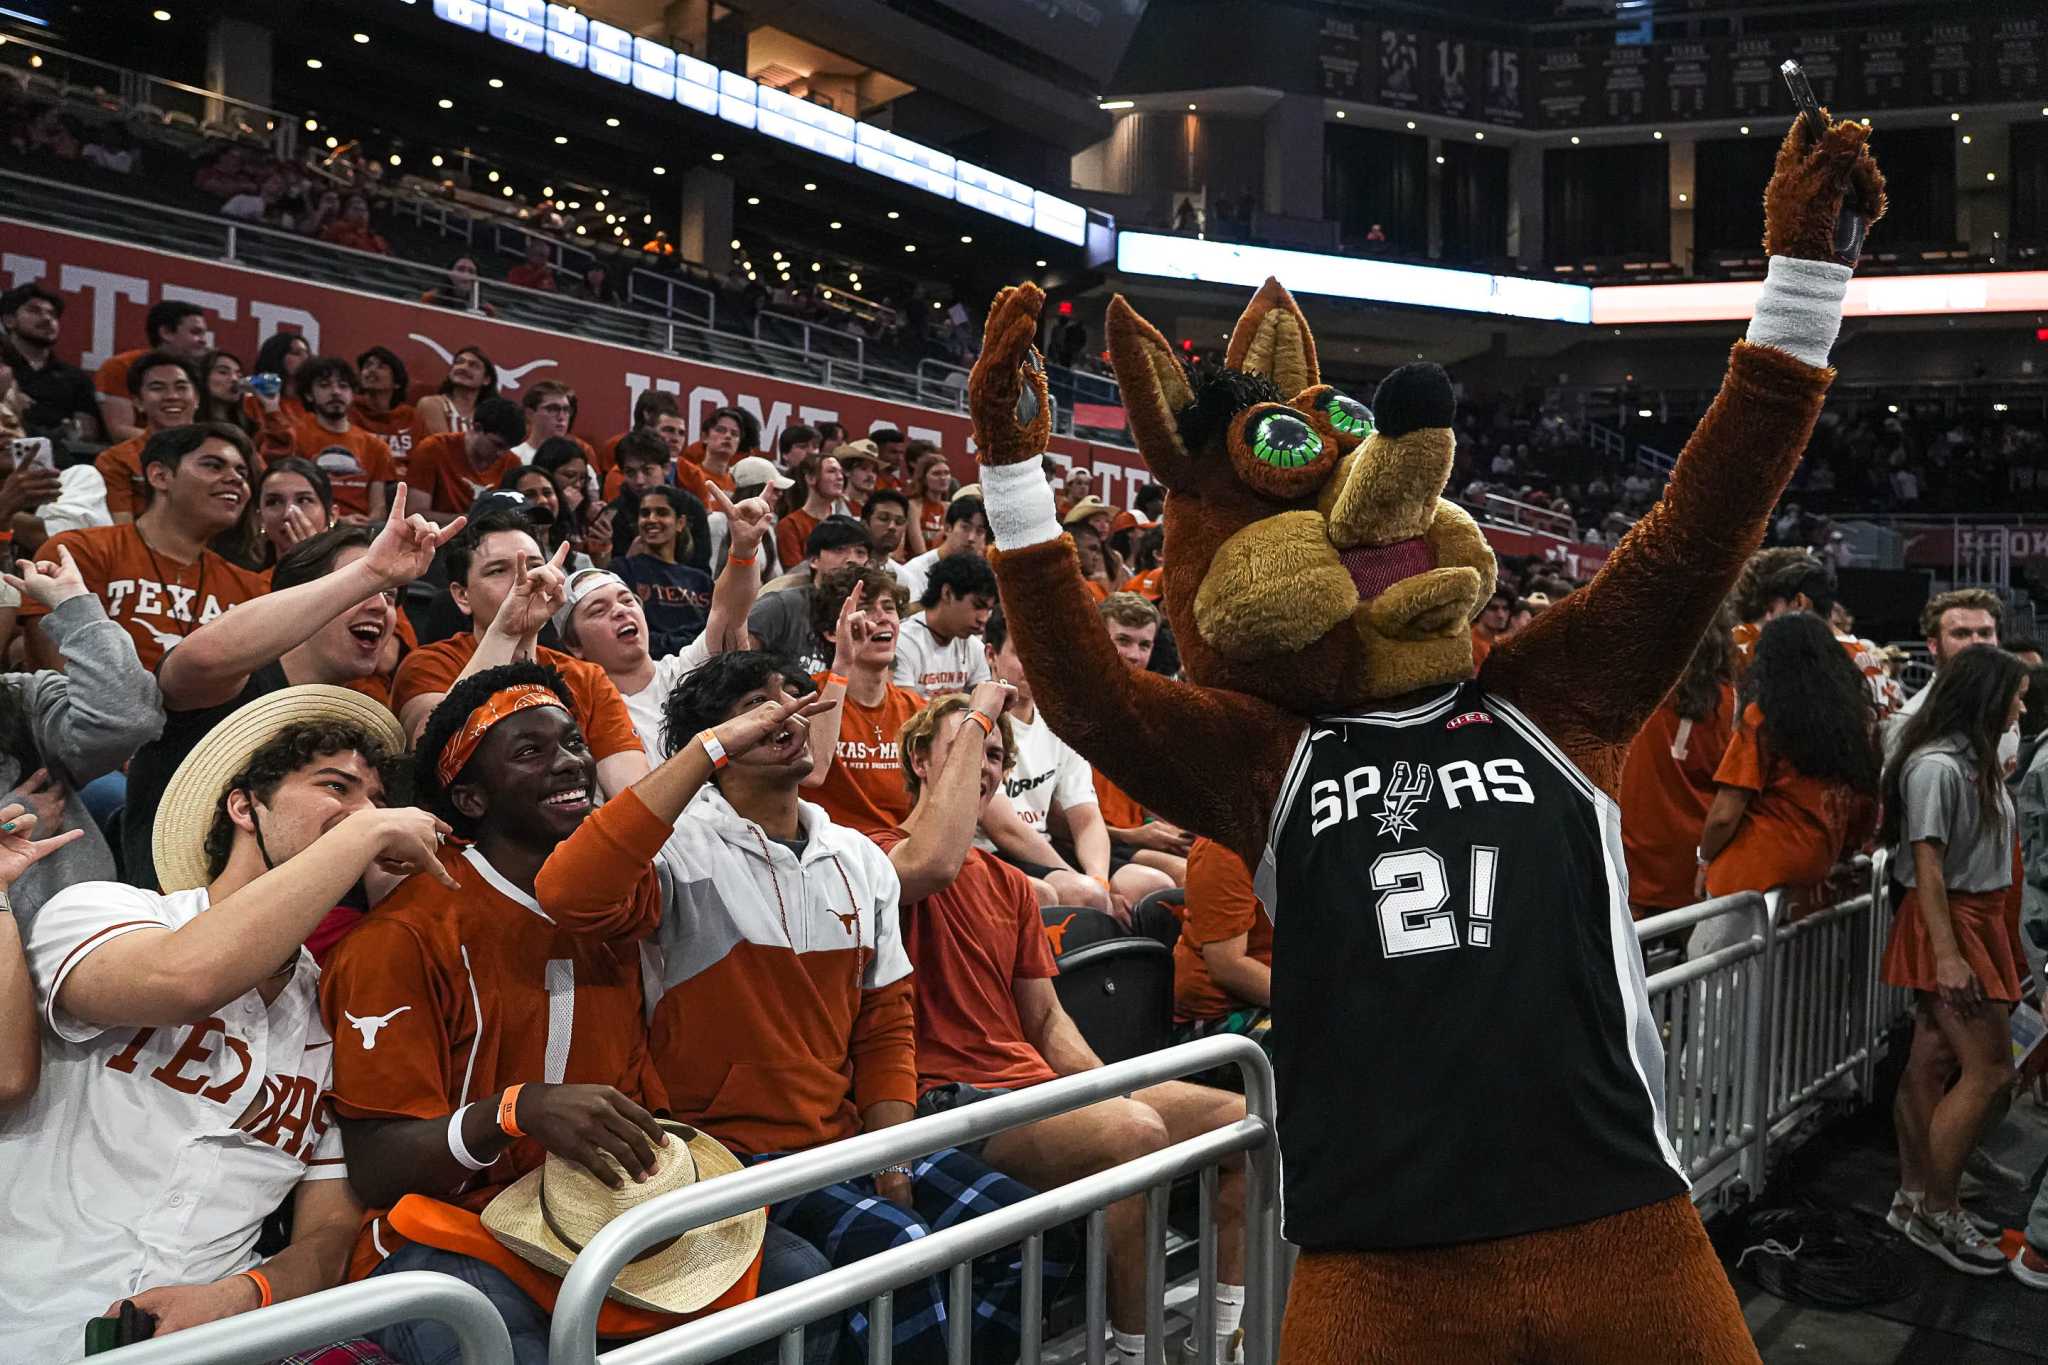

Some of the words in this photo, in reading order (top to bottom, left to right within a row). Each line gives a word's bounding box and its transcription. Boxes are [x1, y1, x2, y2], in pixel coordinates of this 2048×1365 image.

[1489, 49, 1520, 88] 15
[108, 578, 238, 625] TEXA
[652, 584, 711, 607] TEXAS
[1311, 759, 1536, 843] SPURS
